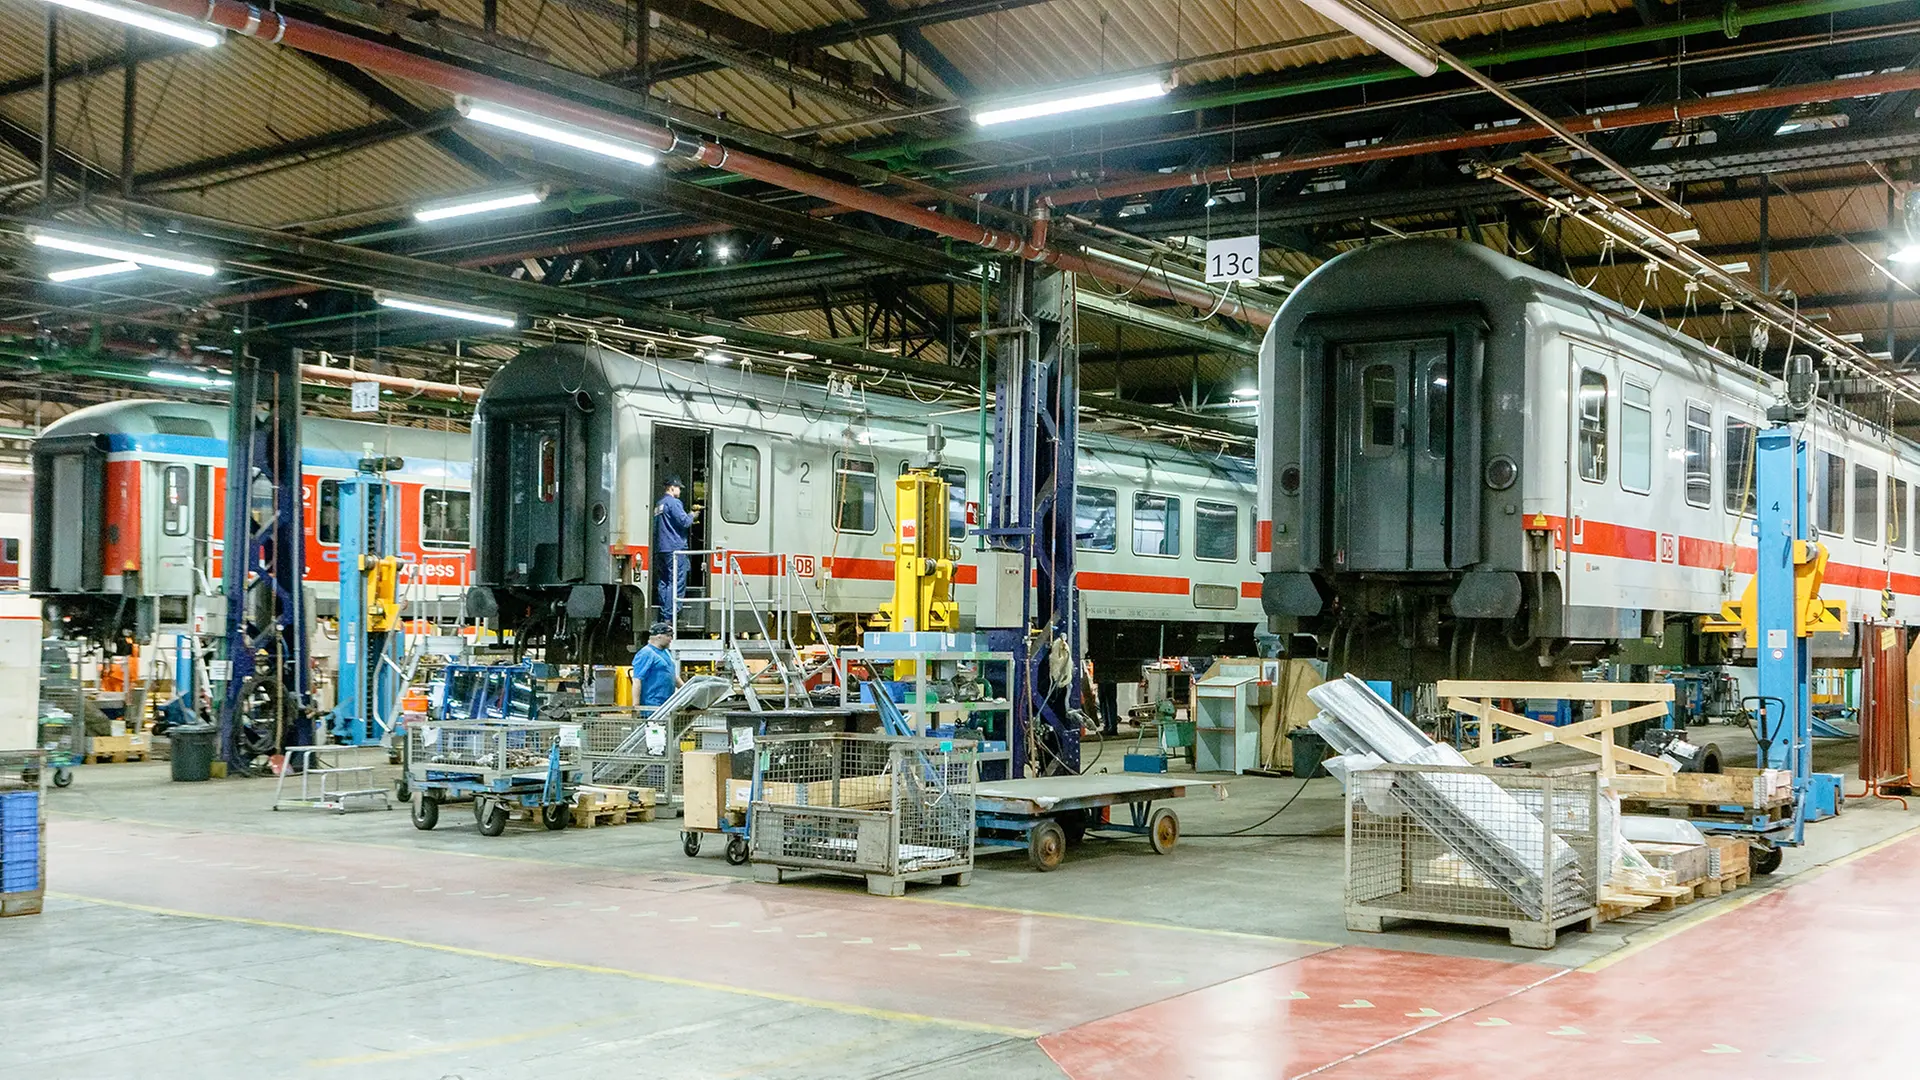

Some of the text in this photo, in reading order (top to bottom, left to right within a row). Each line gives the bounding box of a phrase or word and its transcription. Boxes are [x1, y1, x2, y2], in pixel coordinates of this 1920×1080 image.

[1212, 252, 1254, 278] 13c
[355, 392, 376, 409] 11c
[1665, 408, 1672, 438] 2
[800, 461, 810, 484] 2
[1771, 501, 1780, 512] 4
[1661, 538, 1673, 559] DB
[399, 562, 456, 578] xpress
[796, 558, 813, 574] DB
[906, 561, 911, 570] 4
